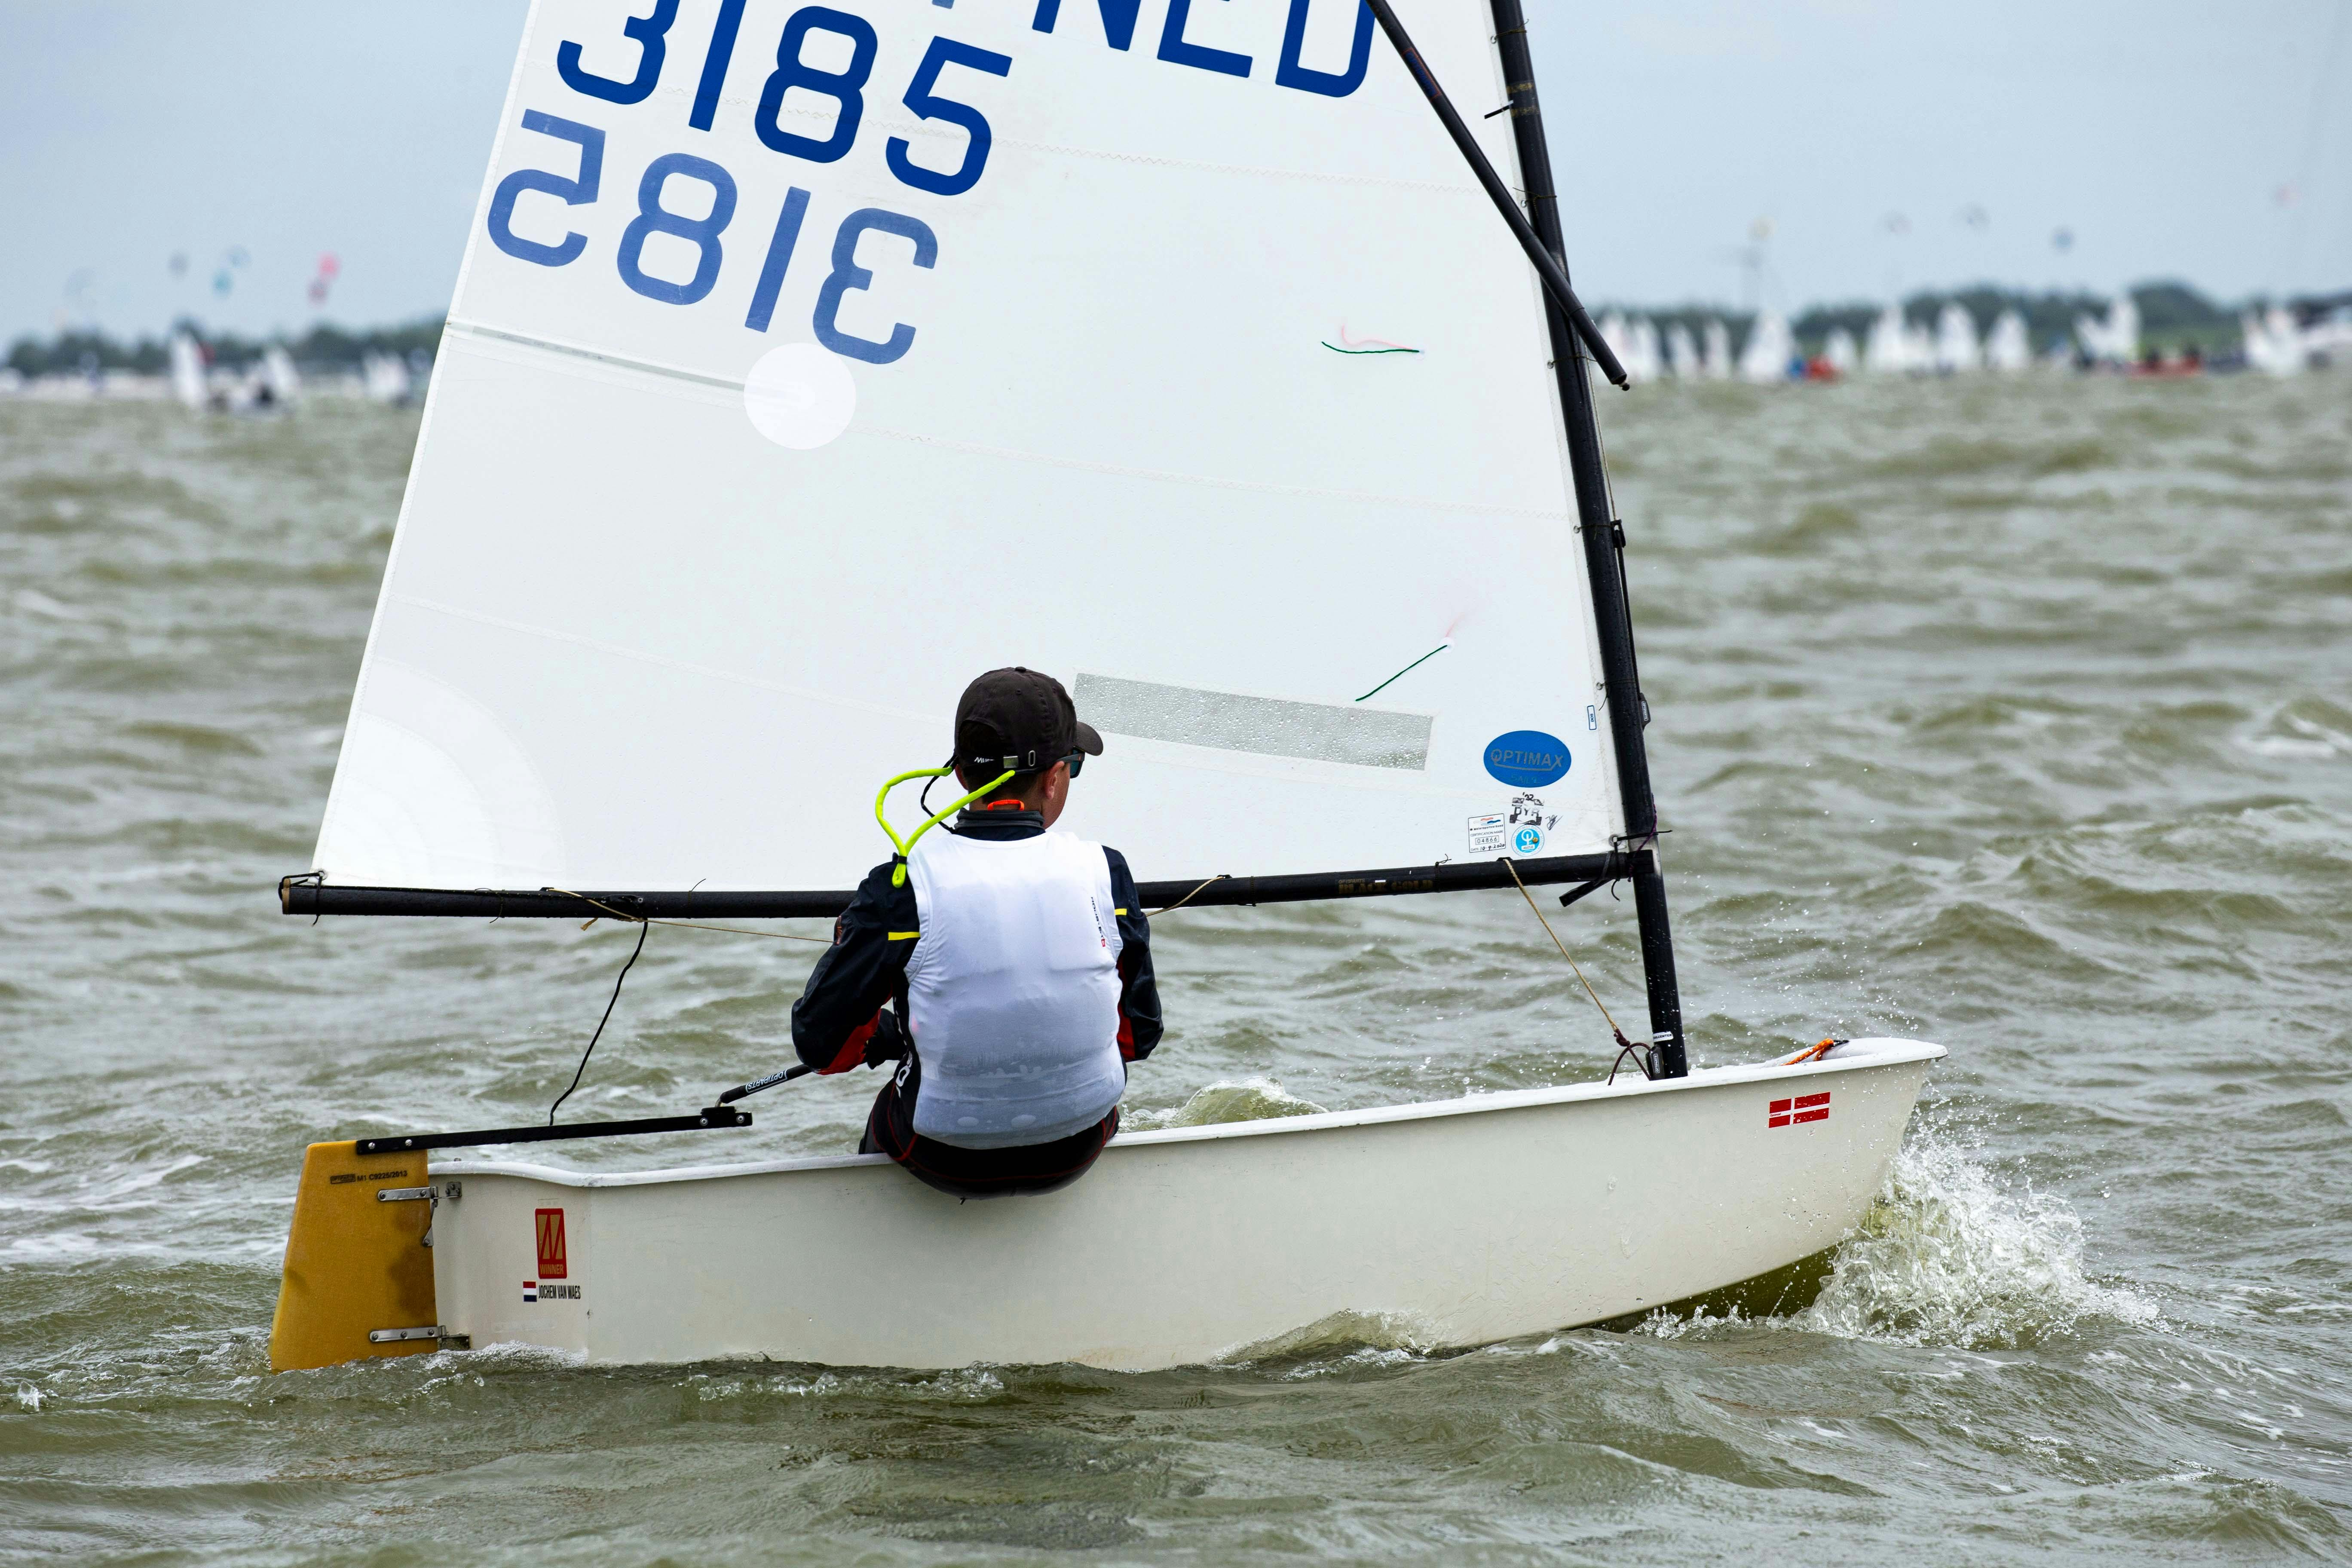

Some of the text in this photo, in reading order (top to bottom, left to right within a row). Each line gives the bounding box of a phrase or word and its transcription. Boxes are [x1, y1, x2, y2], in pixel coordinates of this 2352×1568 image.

[556, 0, 1012, 196] 3185
[1491, 748, 1564, 768] OPTIMAX
[748, 1072, 783, 1089] OPTIPARTS
[540, 1264, 564, 1275] WINNER
[539, 1285, 581, 1299] JOCHEM VAN WAES
